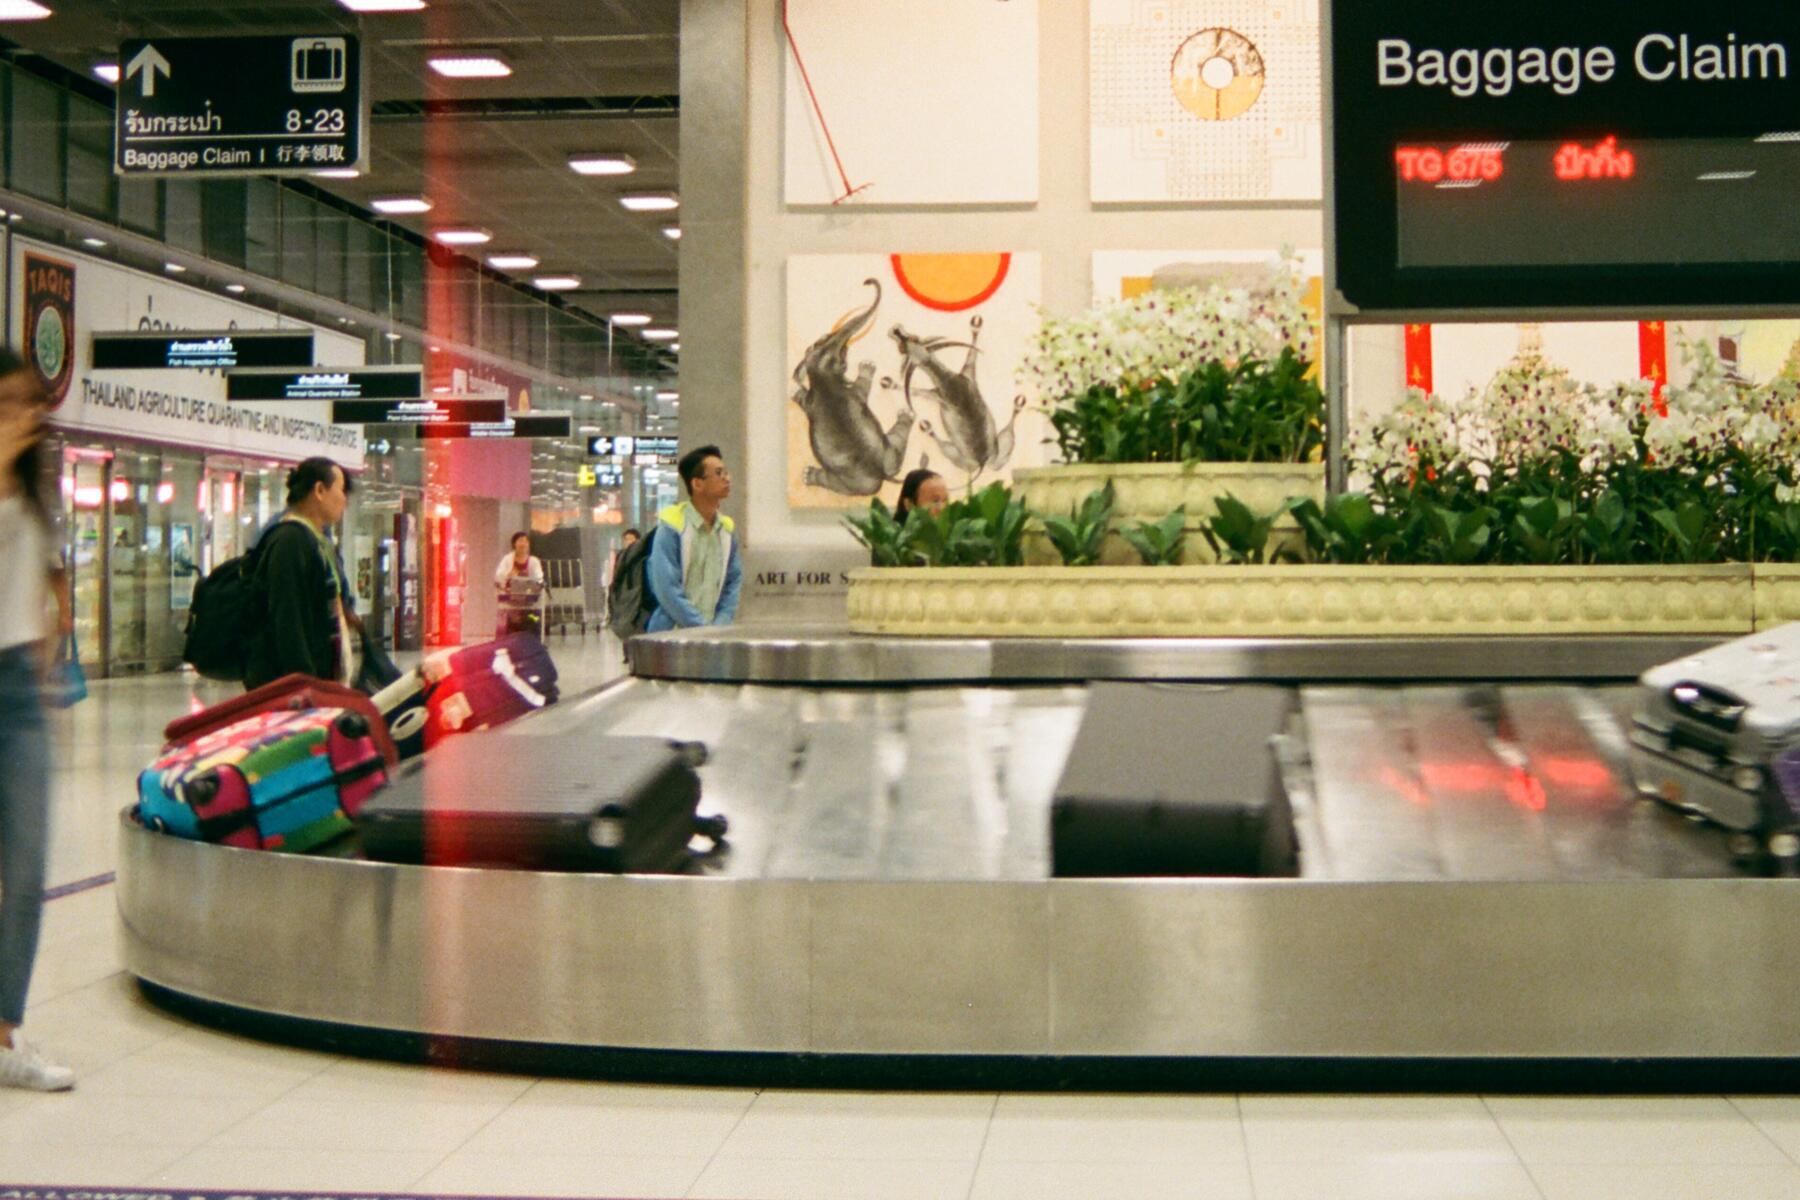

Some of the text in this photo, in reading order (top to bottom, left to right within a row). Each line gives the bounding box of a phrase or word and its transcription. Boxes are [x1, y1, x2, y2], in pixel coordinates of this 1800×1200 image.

[1377, 33, 1787, 97] Baggage Claim
[286, 108, 345, 132] 8-23
[124, 147, 250, 168] Baggage Claim
[1397, 147, 1502, 180] TG 675
[82, 377, 358, 449] THAILAND AGRICULTURE QUARANTINE AND INSPECTION SERVICE
[756, 572, 787, 585] ART
[797, 572, 831, 585] FOR
